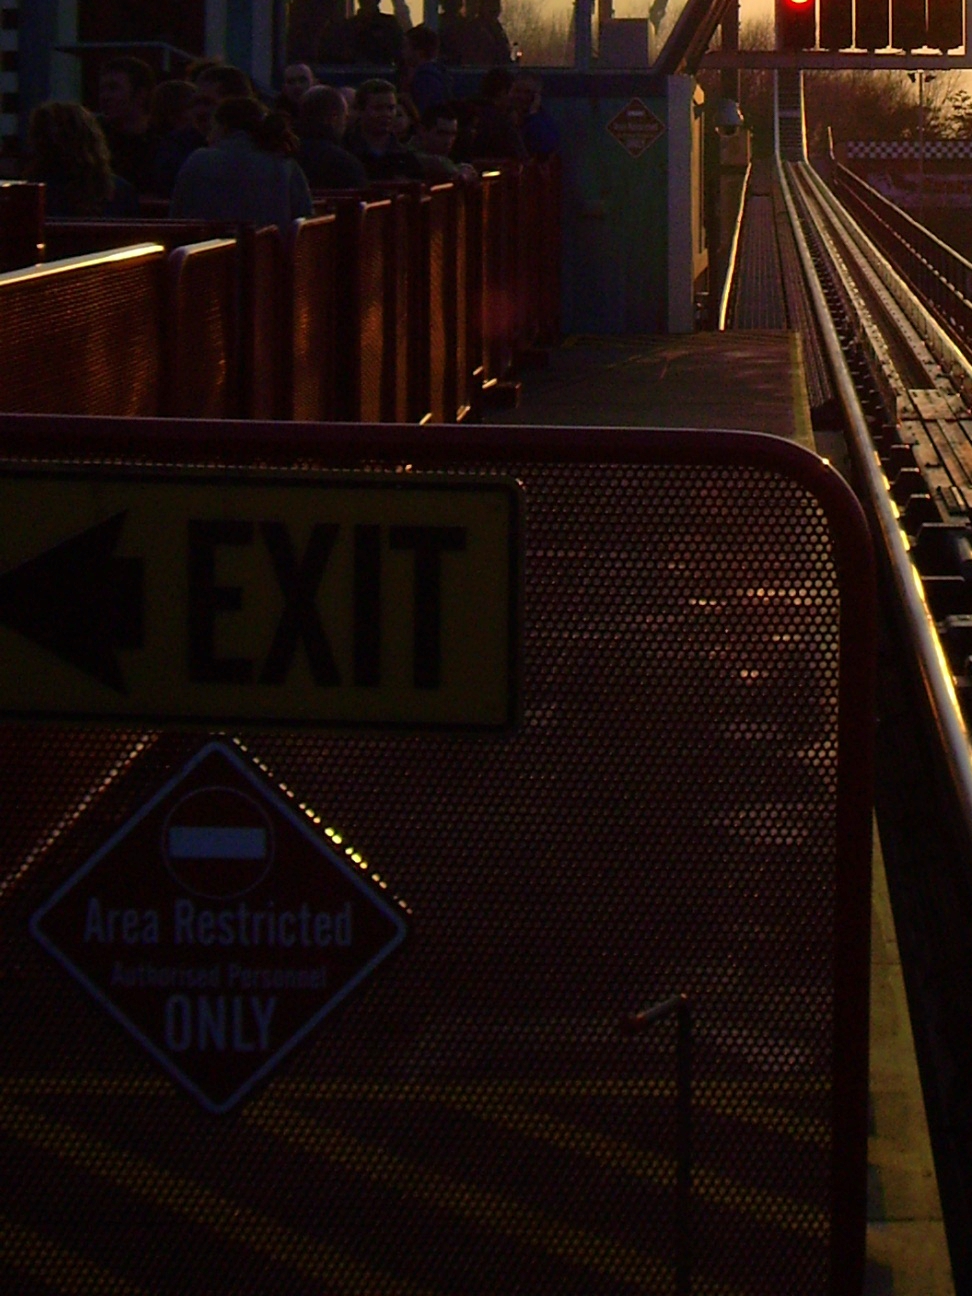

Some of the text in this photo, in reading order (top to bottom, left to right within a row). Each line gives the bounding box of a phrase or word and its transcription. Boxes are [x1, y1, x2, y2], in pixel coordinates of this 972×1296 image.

[187, 519, 467, 689] EXIT
[82, 896, 354, 948] Area Restricted
[163, 994, 277, 1052] ONLY
